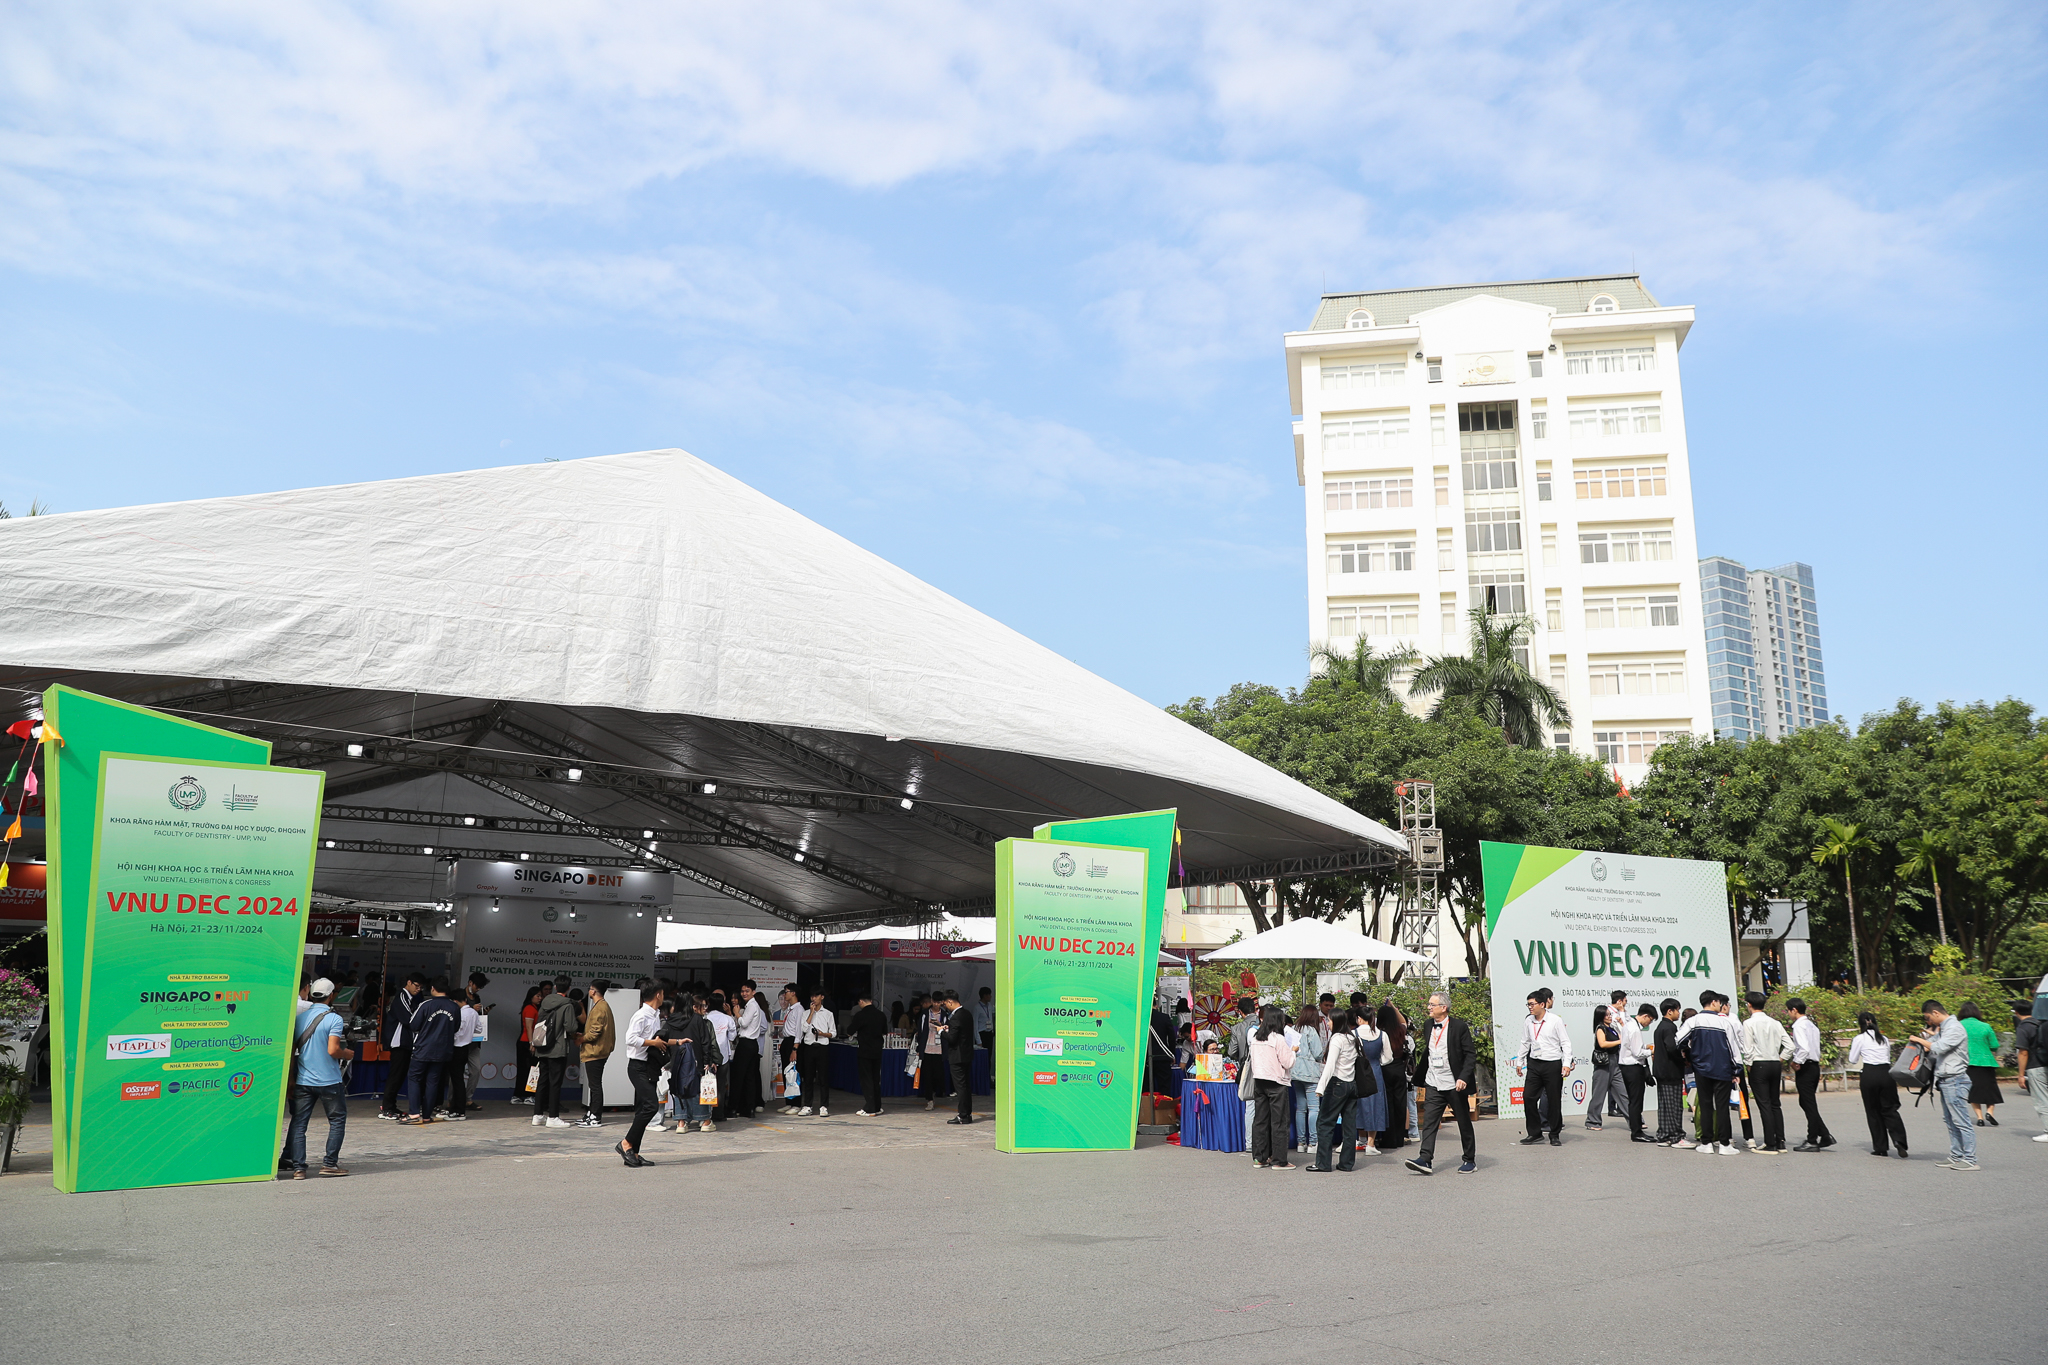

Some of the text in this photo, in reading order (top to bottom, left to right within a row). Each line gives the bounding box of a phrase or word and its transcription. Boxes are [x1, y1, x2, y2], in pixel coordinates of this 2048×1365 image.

[117, 861, 132, 871] HỘI
[134, 864, 155, 872] NGHỊ
[211, 865, 233, 874] TRIỂN
[514, 869, 624, 887] SINGAPO DENT
[106, 892, 298, 916] VNU DEC 2024
[150, 923, 262, 934] Hà Nội, 21-23/11/2024
[314, 925, 343, 936] D.O.E.
[899, 940, 930, 950] PACIFIC
[1018, 935, 1135, 956] VNU DEC 2024
[1514, 939, 1711, 979] VNU DEC 2024
[469, 966, 524, 975] EDUCATION
[537, 969, 582, 978] PRACTICE
[140, 990, 251, 1003] SINGAPO DENT
[1044, 1008, 1111, 1018] SINGAPO DENT
[109, 1041, 167, 1052] VITAPLUS
[174, 1036, 273, 1050] Operation Smile
[1026, 1042, 1060, 1050] VITAPLUS
[1064, 1042, 1125, 1052] Operation Smile
[1574, 1057, 1589, 1065] Smile
[182, 1079, 220, 1090] PACIFIC
